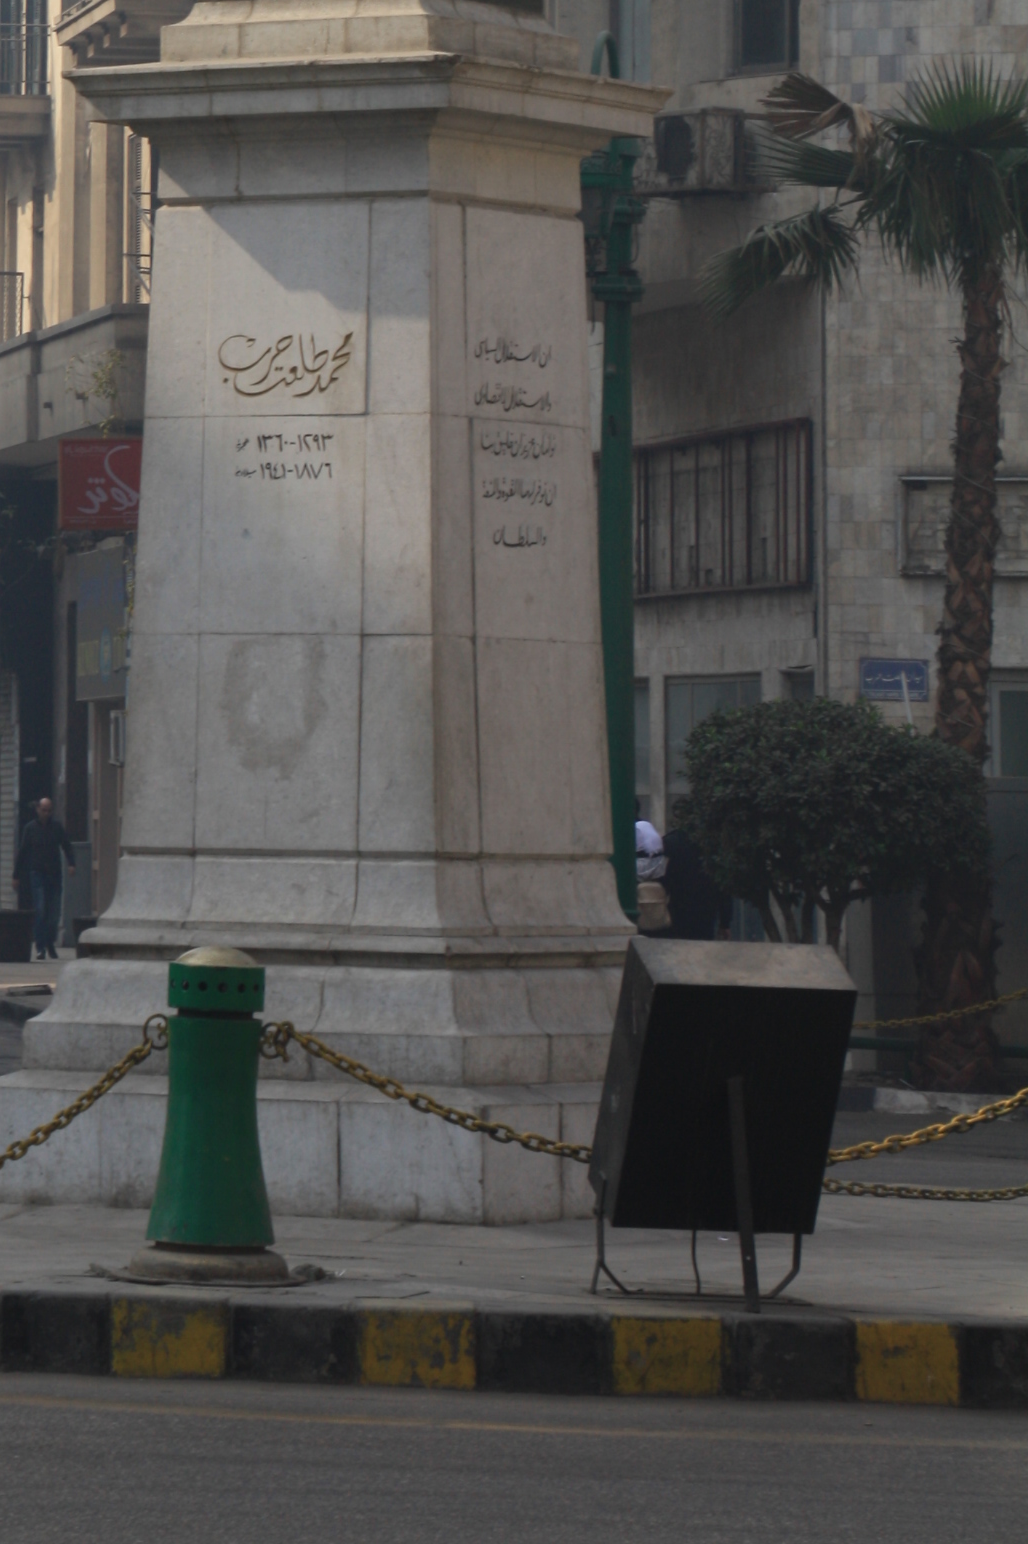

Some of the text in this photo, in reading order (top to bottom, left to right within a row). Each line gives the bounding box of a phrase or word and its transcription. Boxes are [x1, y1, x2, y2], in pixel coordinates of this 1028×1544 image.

[218, 331, 354, 398] محمد طلعت حرب
[493, 524, 548, 548] والسلطان
